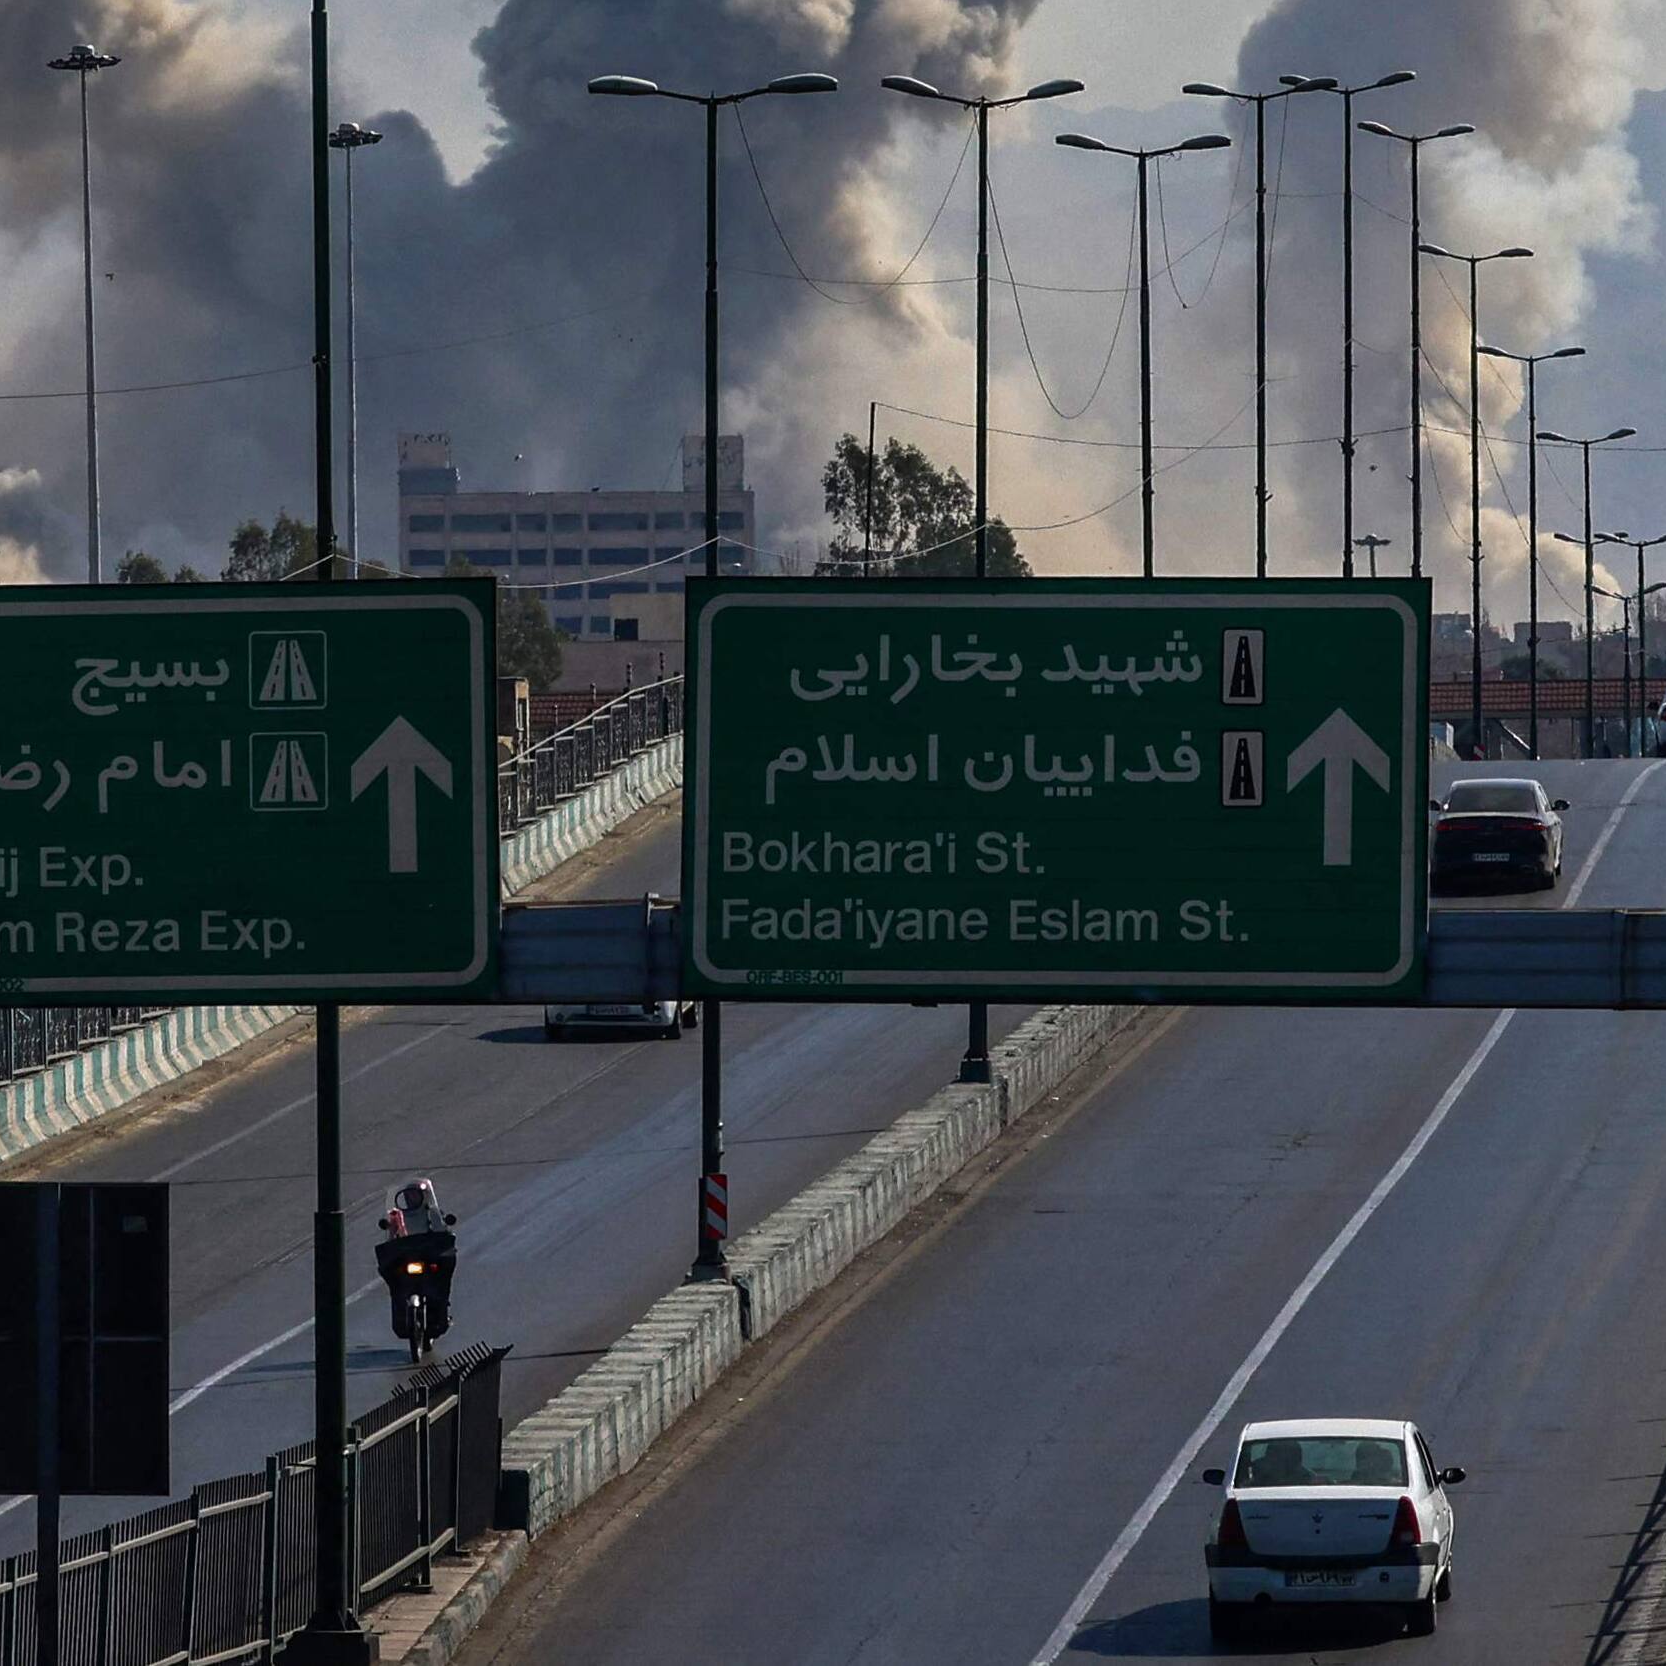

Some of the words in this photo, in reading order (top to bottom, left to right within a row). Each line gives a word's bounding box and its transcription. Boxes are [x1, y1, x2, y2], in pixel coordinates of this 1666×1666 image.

[72, 657, 230, 715] بسیج
[790, 634, 1023, 704] بخارایی
[1041, 630, 1203, 695] شهید
[99, 740, 231, 813] امام
[765, 734, 938, 805] اسلام
[964, 731, 1201, 797] فداییان
[39, 847, 144, 894] Exp.
[723, 831, 956, 874] Bokhara'i
[976, 832, 1045, 874] St.
[56, 912, 180, 953] Reza
[200, 910, 305, 958] Exp.
[722, 898, 989, 949] Fada'iyane
[1010, 899, 1159, 942] Eslam
[1180, 899, 1248, 942] St.
